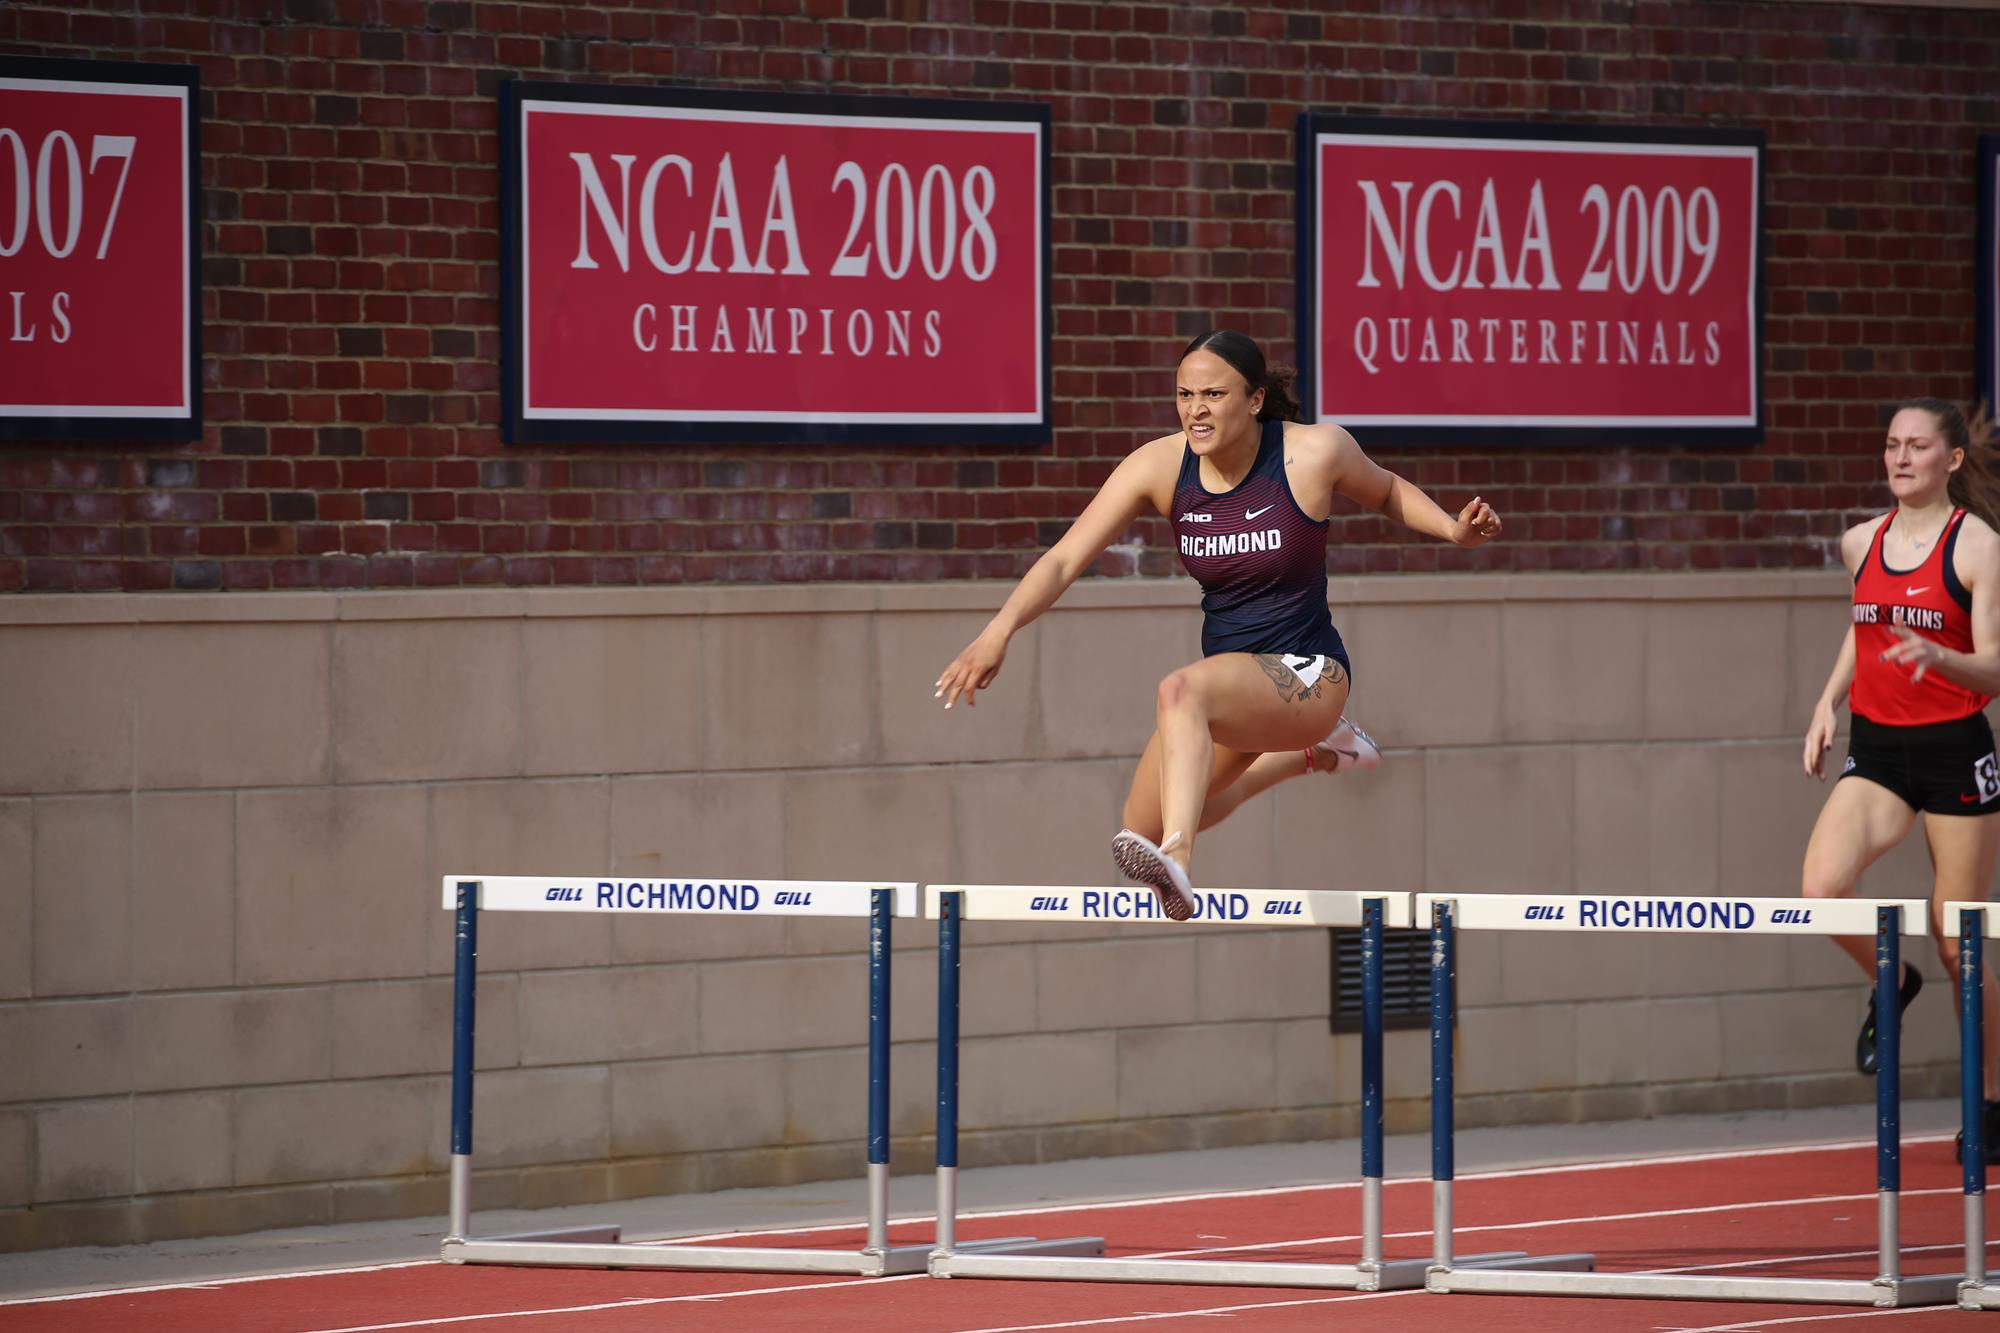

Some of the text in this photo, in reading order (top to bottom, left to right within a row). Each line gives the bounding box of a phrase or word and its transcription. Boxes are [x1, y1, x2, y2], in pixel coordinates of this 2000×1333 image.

[569, 151, 998, 281] NCAA 2008
[1357, 177, 1720, 296] NCAA 2009
[9, 291, 72, 344] LS
[632, 302, 942, 357] CHAMPIONS
[1354, 316, 1721, 374] QUARTERFINALS
[1181, 528, 1282, 557] RICHMOND
[1980, 757, 1998, 796] 8
[545, 882, 812, 911] GILL RICHMOND GILL
[1030, 896, 1069, 911] GILL
[1263, 900, 1303, 915] GILL
[1524, 900, 1812, 929] GILL RICHMOND GILL
